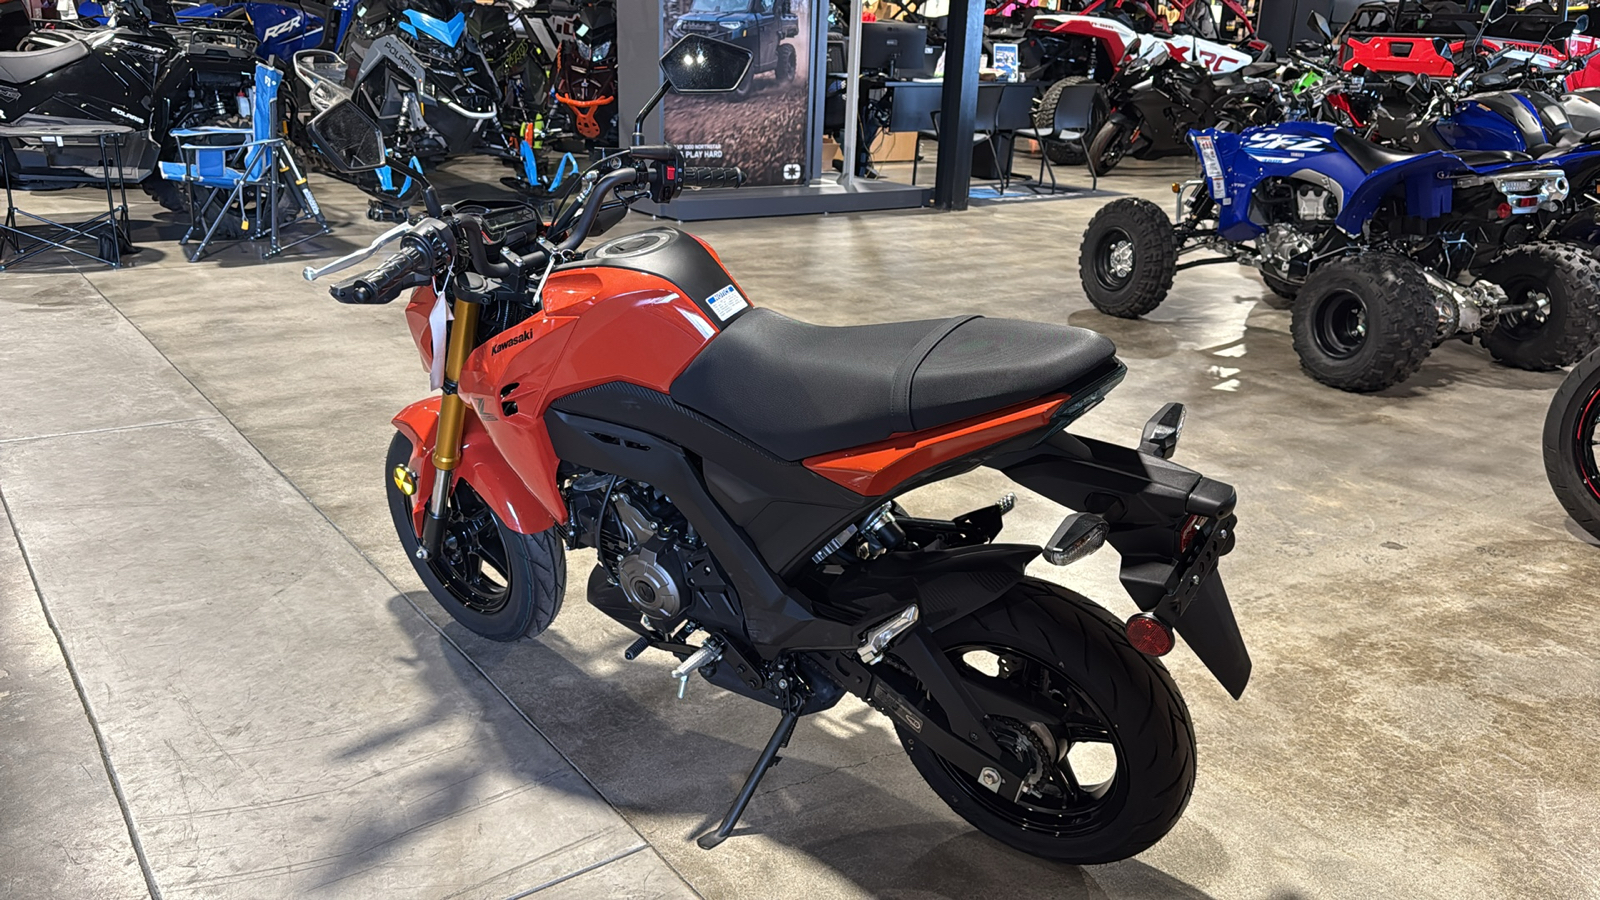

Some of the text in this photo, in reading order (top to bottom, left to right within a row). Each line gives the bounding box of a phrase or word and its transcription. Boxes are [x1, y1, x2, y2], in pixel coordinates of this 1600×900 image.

[263, 16, 301, 43] RZR
[384, 42, 418, 75] POLARIS
[1164, 41, 1191, 63] X
[1503, 42, 1554, 57] NERAL
[111, 107, 145, 124] POLARIS
[1245, 133, 1332, 153] YFZ
[491, 328, 533, 356] Kawasaki
